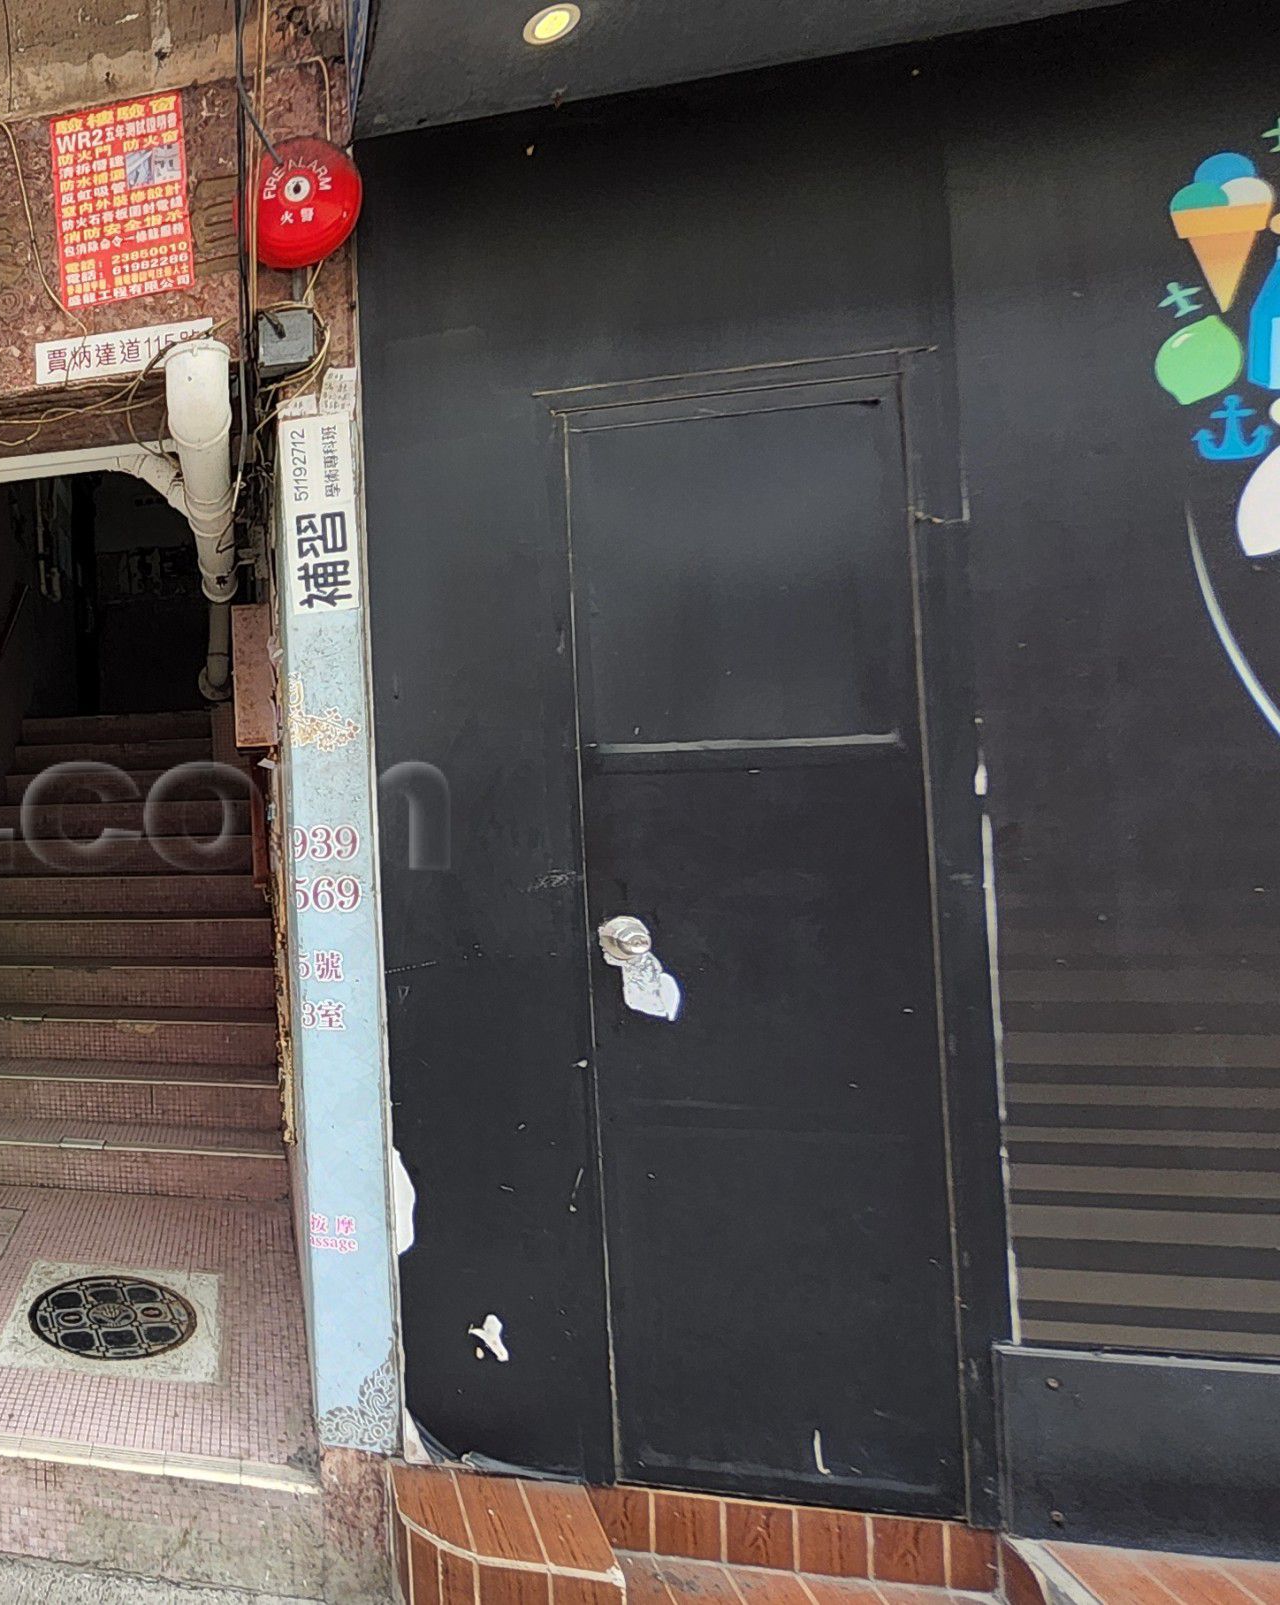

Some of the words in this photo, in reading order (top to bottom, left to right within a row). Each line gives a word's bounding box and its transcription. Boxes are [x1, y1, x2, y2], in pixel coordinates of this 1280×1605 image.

[56, 129, 103, 154] WR2
[57, 145, 111, 167] 防火門
[123, 130, 179, 151] 防火窗
[263, 166, 285, 200] FIRE
[288, 156, 332, 190] ALARM
[290, 428, 309, 501] 51192712
[322, 425, 340, 498] 學術專科班
[296, 511, 352, 608] 補習
